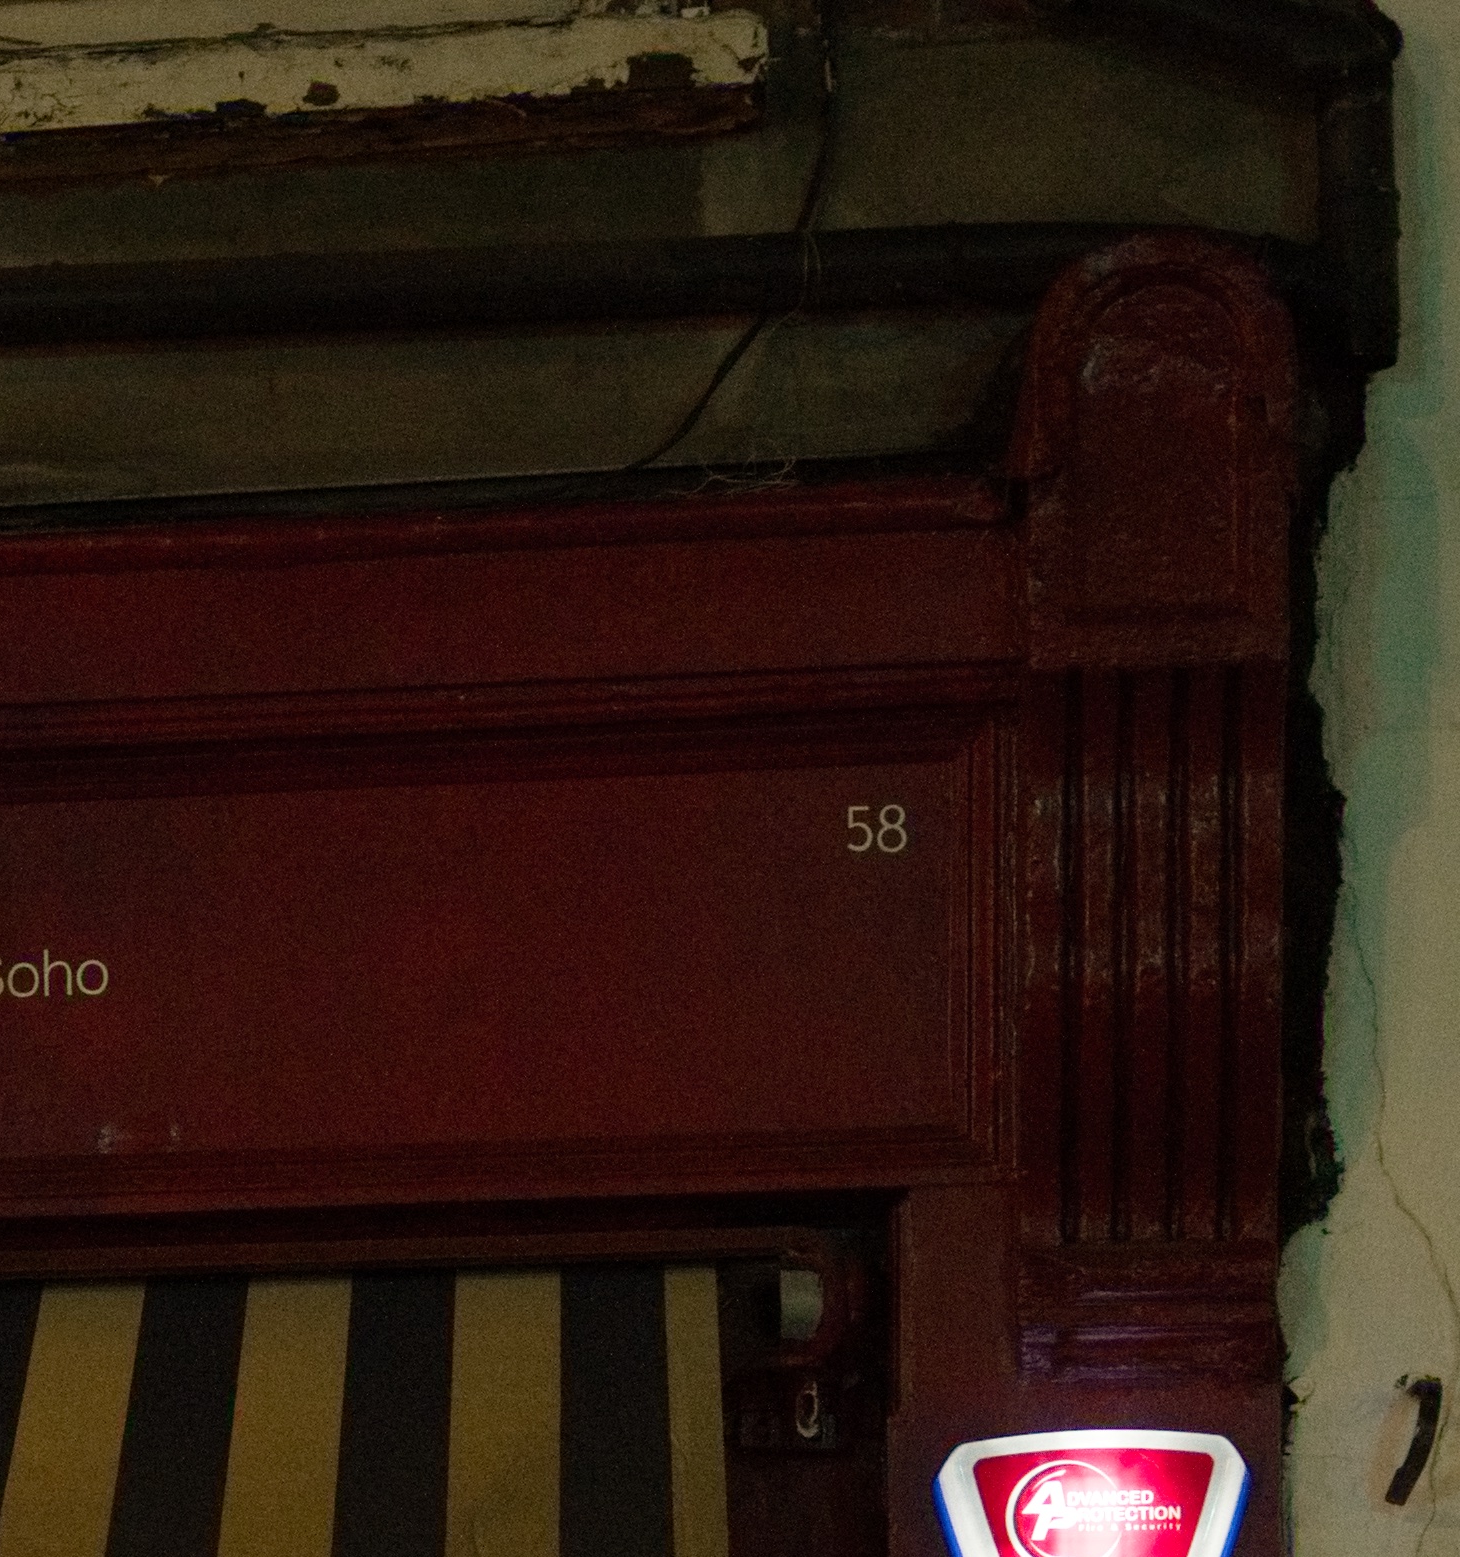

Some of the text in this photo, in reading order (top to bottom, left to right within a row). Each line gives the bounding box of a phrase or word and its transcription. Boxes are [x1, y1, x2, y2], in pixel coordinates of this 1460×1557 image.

[847, 804, 908, 853] 58
[1022, 1480, 1154, 1515] ADVANCED
[1031, 1505, 1182, 1541] PROTECTION
[1125, 1521, 1182, 1532] Security
